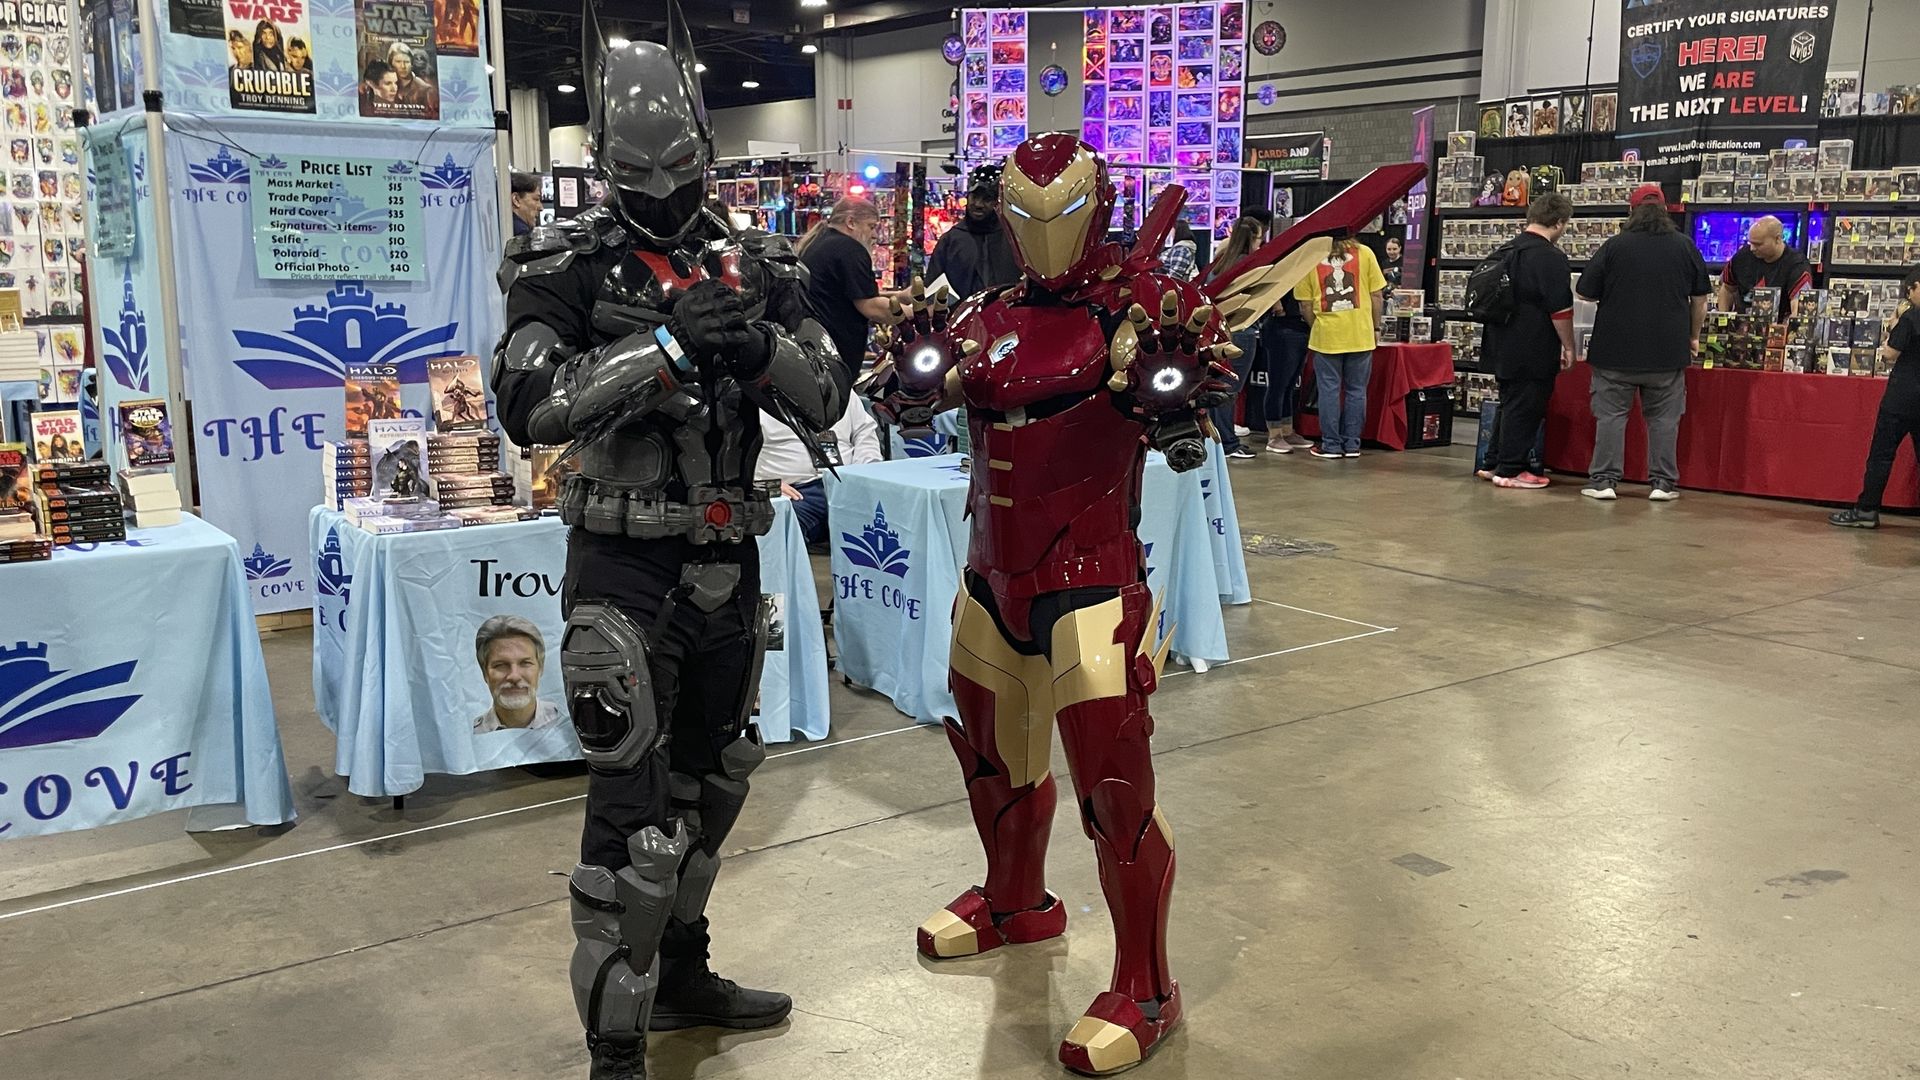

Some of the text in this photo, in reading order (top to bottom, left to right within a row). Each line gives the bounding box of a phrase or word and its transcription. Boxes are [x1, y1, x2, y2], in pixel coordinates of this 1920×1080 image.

[21, 2, 67, 27] CHAO
[229, 3, 303, 24] WARS
[365, 3, 430, 21] STAR
[367, 18, 434, 36] WARS
[1627, 6, 1829, 38] CERTIFY YOUR SIGNATURES
[1678, 35, 1768, 67] HERE!
[233, 68, 311, 97] CRUCIBLE
[1679, 71, 1755, 92] WE ARE
[241, 93, 263, 104] TROY
[265, 95, 306, 106] DENNING
[1630, 95, 1808, 123] THE NEXT LEVEL!
[1258, 149, 1289, 159] CARDS
[1289, 146, 1310, 158] AND
[300, 159, 373, 177] PRICE LIST
[267, 178, 403, 191] Mass Market $15
[182, 187, 248, 204] THE CO
[268, 192, 404, 205] Trade Paper $25
[420, 193, 443, 208] HE
[269, 206, 404, 219] Hard Cover $35
[270, 220, 328, 232] Signatures
[389, 223, 405, 232] $10
[271, 234, 405, 246] Selfie $10
[273, 248, 409, 260] Polaroid $20
[274, 262, 410, 273] Official Photo $40
[349, 366, 397, 375] HALO
[430, 359, 477, 370] HALO
[36, 418, 77, 428] STAR
[37, 425, 77, 436] WARS
[374, 424, 422, 432] HALO
[203, 406, 326, 461] THE
[260, 579, 306, 598] COVE
[833, 573, 921, 620] THE COVE
